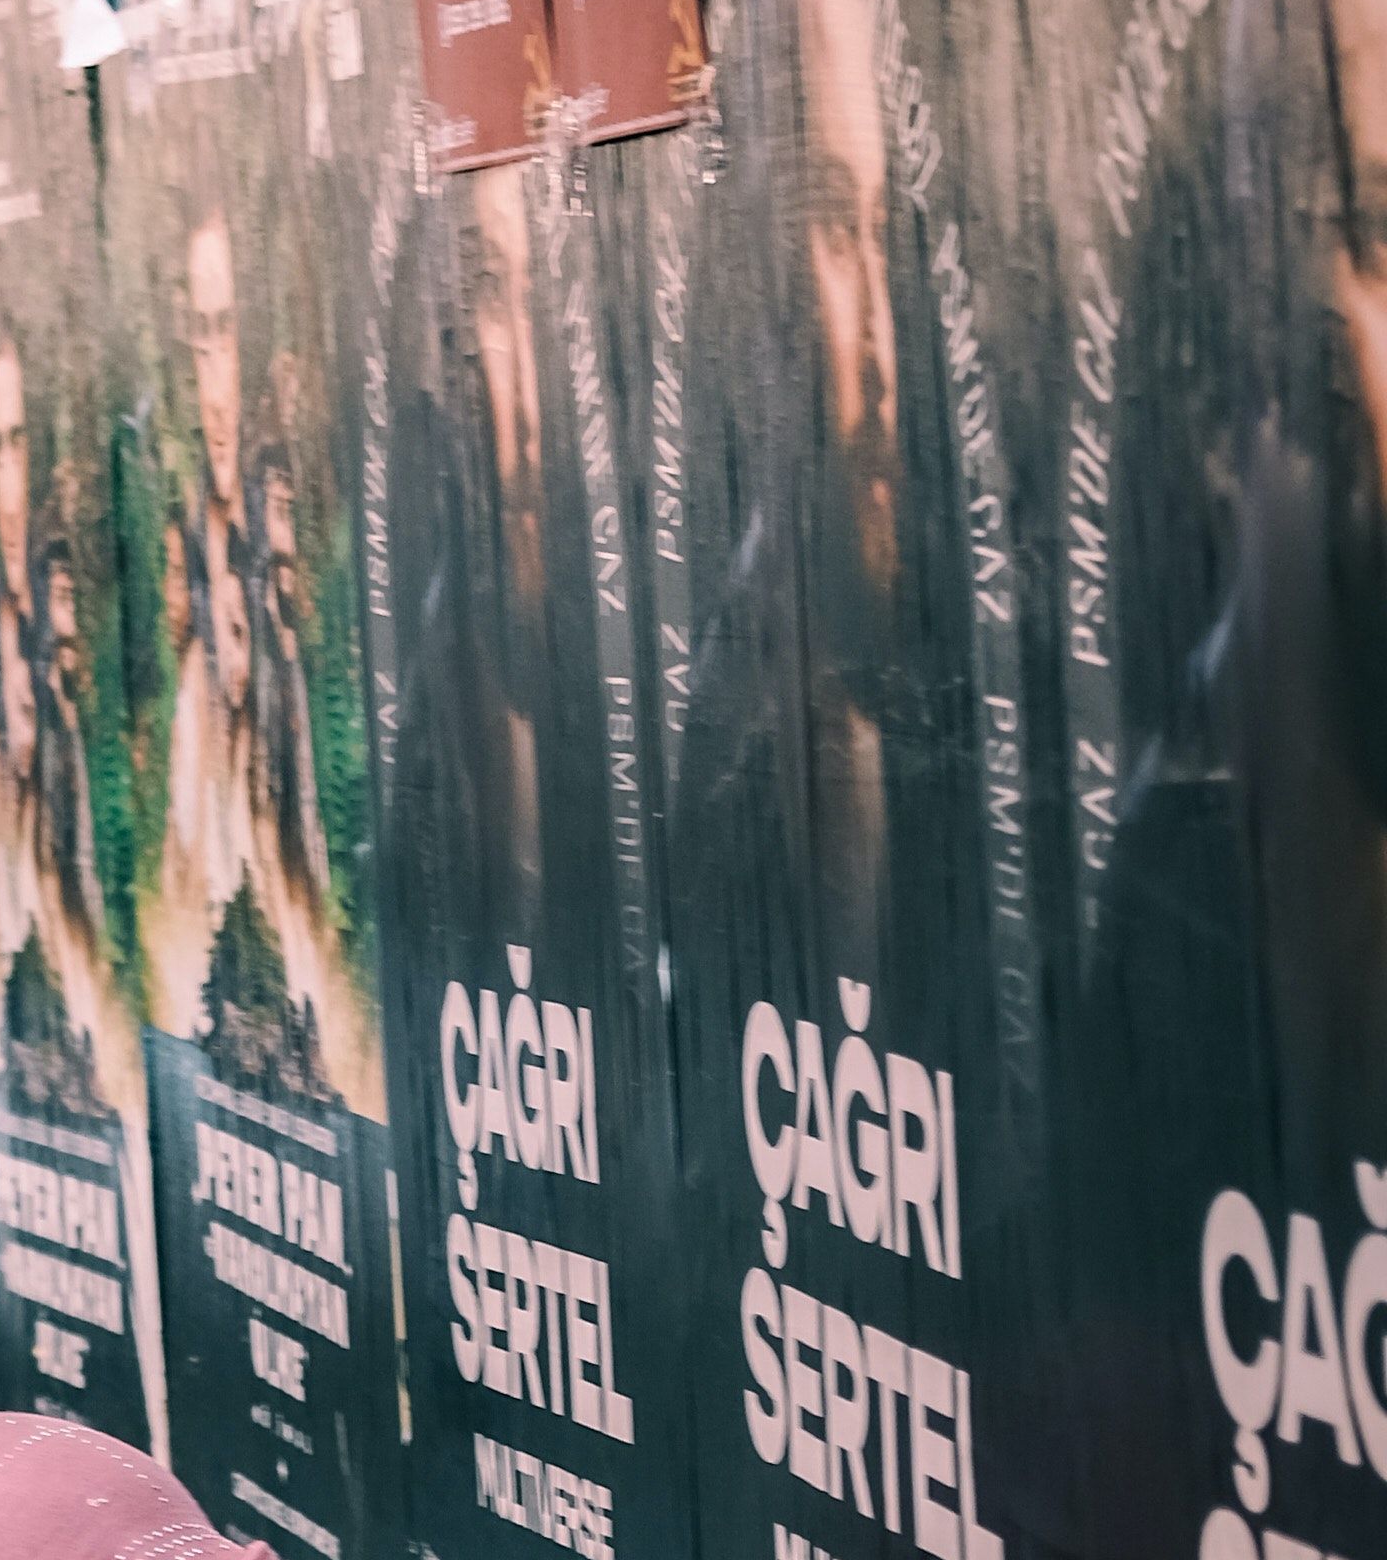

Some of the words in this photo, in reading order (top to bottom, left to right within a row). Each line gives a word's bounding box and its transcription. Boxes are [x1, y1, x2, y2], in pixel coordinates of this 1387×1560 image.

[440, 943, 600, 1210] ÇAĞRI
[741, 976, 962, 1280] ÇAĞRI
[447, 1214, 635, 1445] SERTEL
